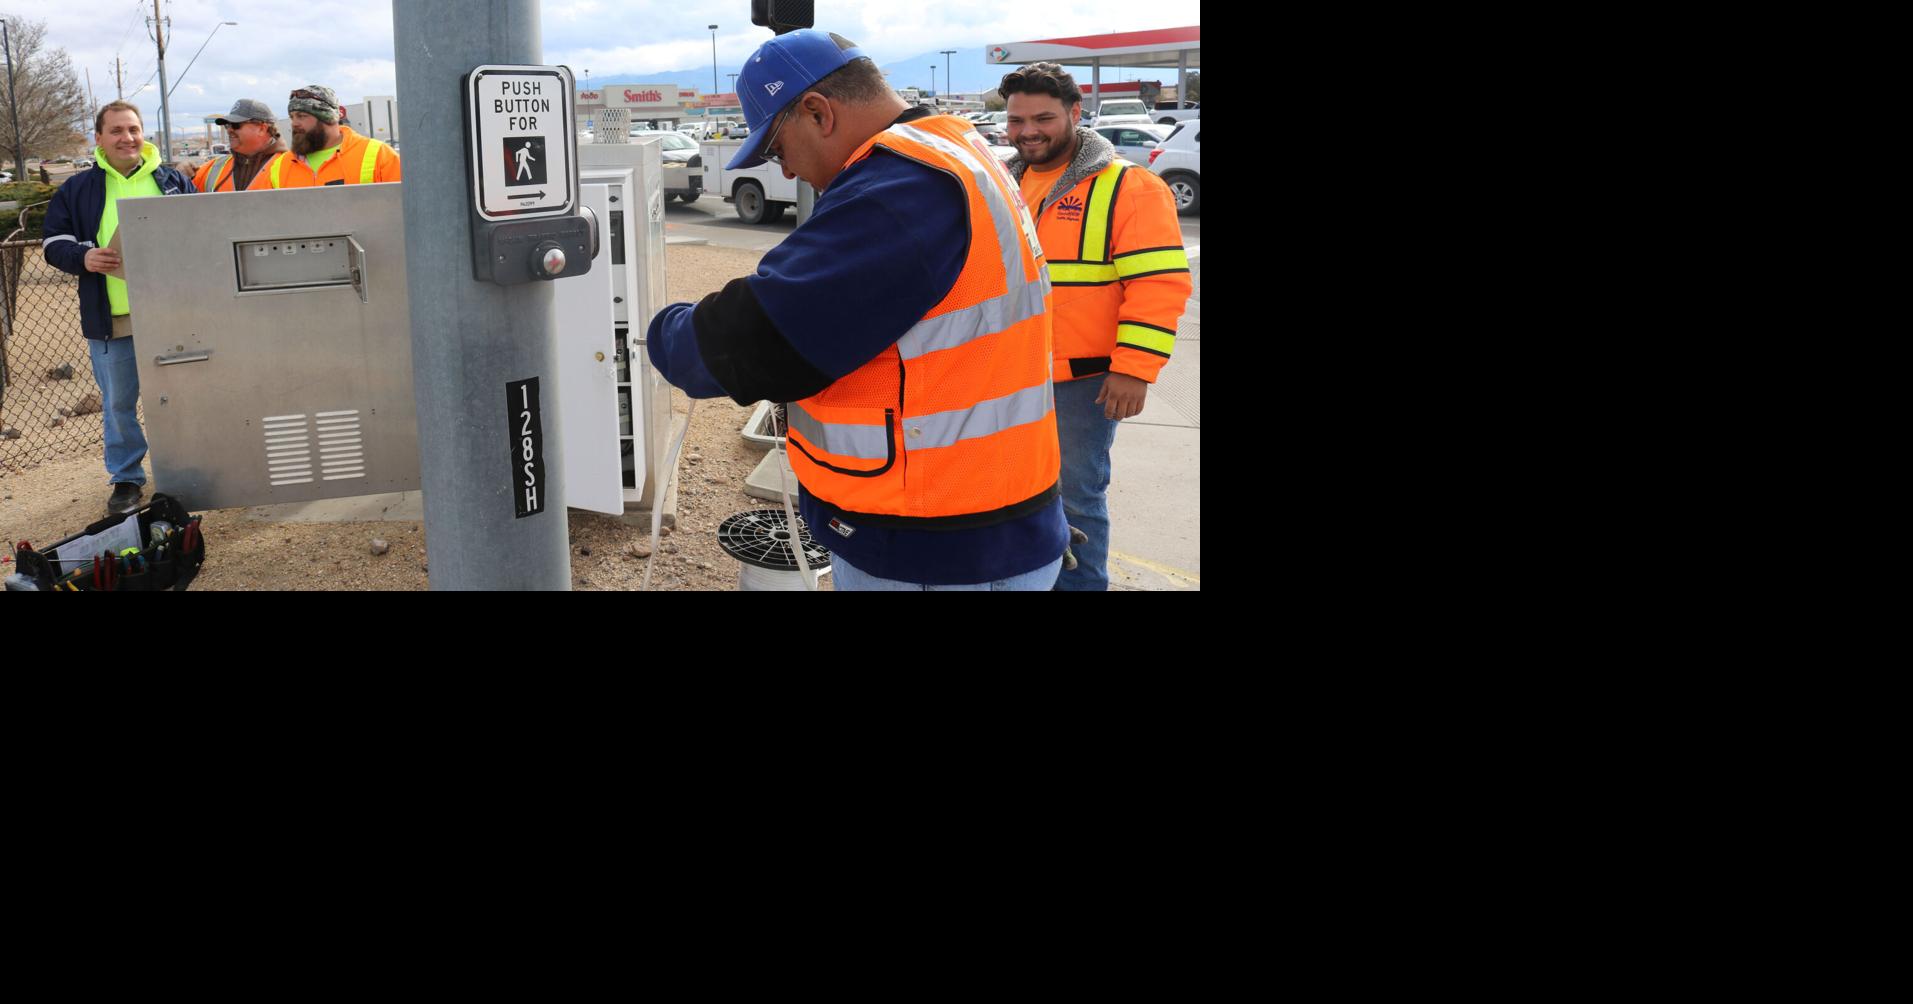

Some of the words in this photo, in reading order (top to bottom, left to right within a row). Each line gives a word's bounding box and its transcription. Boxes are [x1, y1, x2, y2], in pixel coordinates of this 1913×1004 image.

[502, 81, 541, 95] PUSH
[623, 89, 662, 103] Smith's
[494, 99, 550, 113] BUTTON
[509, 116, 538, 131] FOR
[520, 384, 538, 512] 128SH
